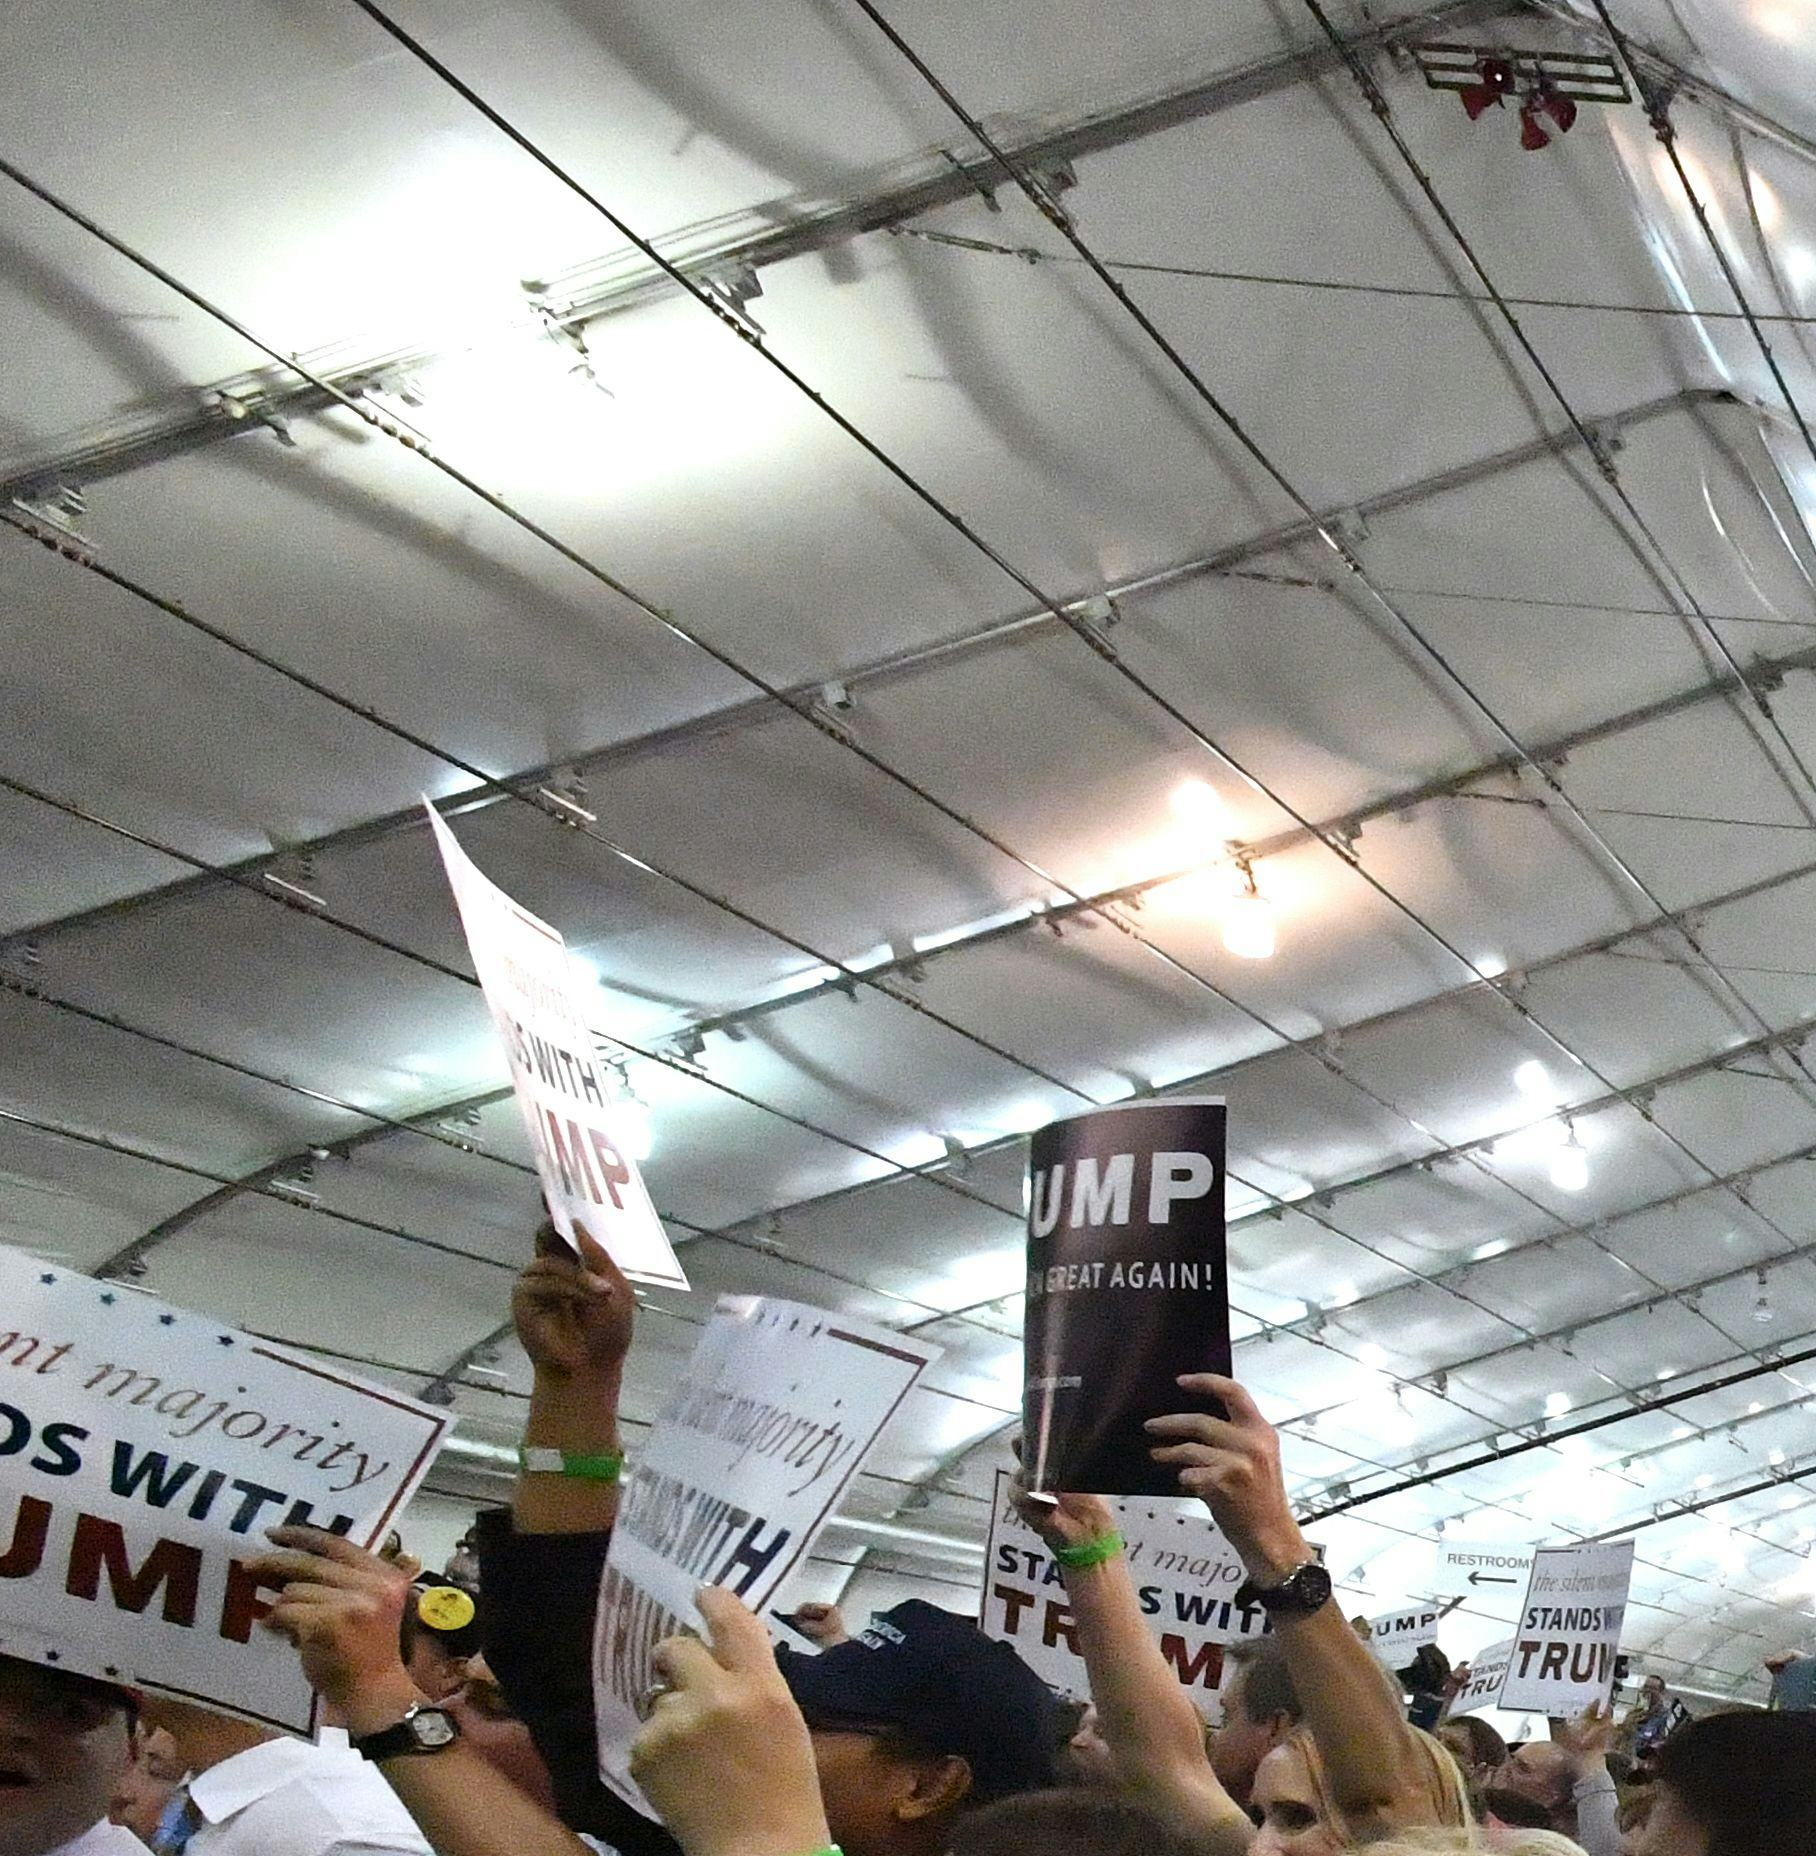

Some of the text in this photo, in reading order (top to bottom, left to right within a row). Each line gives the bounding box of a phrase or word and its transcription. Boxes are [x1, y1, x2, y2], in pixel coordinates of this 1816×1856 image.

[1032, 1151, 1214, 1240] UMP
[1110, 1261, 1213, 1291] AGAIN!
[84, 1362, 392, 1493] majority
[1153, 1548, 1242, 1588] majo
[1376, 1613, 1437, 1637] UMP
[1525, 1607, 1601, 1632] STANDS
[1461, 1675, 1504, 1700] TRU
